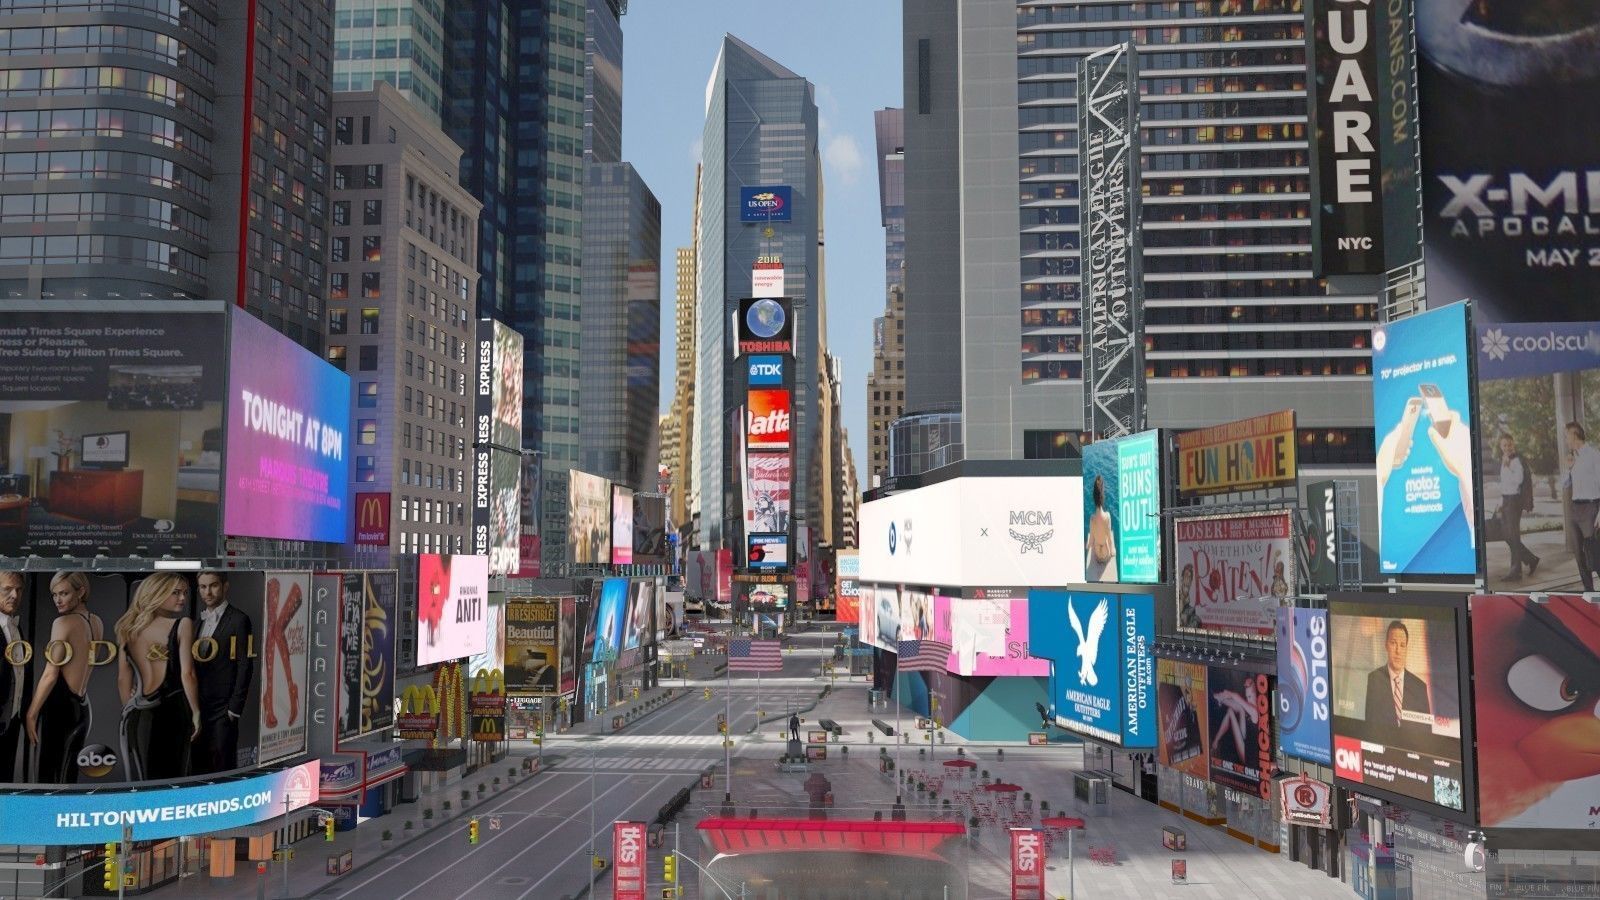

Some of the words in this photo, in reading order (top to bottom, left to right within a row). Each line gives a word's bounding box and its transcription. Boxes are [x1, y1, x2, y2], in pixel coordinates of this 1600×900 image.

[1327, 0, 1375, 203] UARE
[1338, 237, 1373, 250] NYC
[1526, 248, 1580, 267] MAY
[30, 327, 62, 336] Times
[64, 327, 101, 338] Square
[104, 327, 165, 338] Experience
[22, 348, 56, 358] Suites
[58, 348, 69, 359] by
[74, 348, 106, 358] Hilton
[108, 348, 140, 358] Times
[740, 341, 791, 353] TOSHIBA
[480, 340, 491, 396] EXPRESS
[758, 364, 782, 376] TDK
[242, 390, 304, 444] TONIGHT
[305, 416, 320, 451] AT
[322, 424, 342, 462] 8PM
[1186, 447, 1218, 487] FUN
[1226, 436, 1286, 481] HOME
[478, 452, 488, 508] EXPRESS
[1122, 469, 1152, 498] BUNS
[1009, 510, 1052, 526] MCM
[1180, 520, 1228, 540] LOSER!
[1324, 488, 1336, 564] NEW
[1261, 527, 1284, 537] AWARD
[456, 598, 481, 624] ANTI
[508, 625, 554, 639] Beautiful
[1126, 608, 1136, 654] EAGLE
[147, 643, 170, 662] &
[192, 634, 258, 663] OIL
[314, 587, 328, 725] PALACE
[1310, 616, 1328, 700] SOLO
[1137, 634, 1146, 709] OUTFITTERS
[1066, 689, 1093, 706] AMERICAN
[1093, 696, 1110, 712] EAGLE
[1128, 657, 1138, 736] AMERICAN
[1312, 702, 1328, 721] 2
[1257, 673, 1272, 800] CHICAGO
[77, 746, 117, 767] abc
[1335, 748, 1361, 773] CNN
[1185, 776, 1204, 790] GRAND
[57, 790, 272, 828] HILTONWEEKENDS.COM
[1224, 790, 1241, 804] SLAM
[622, 826, 641, 864] tkts
[1018, 834, 1038, 872] tkts
